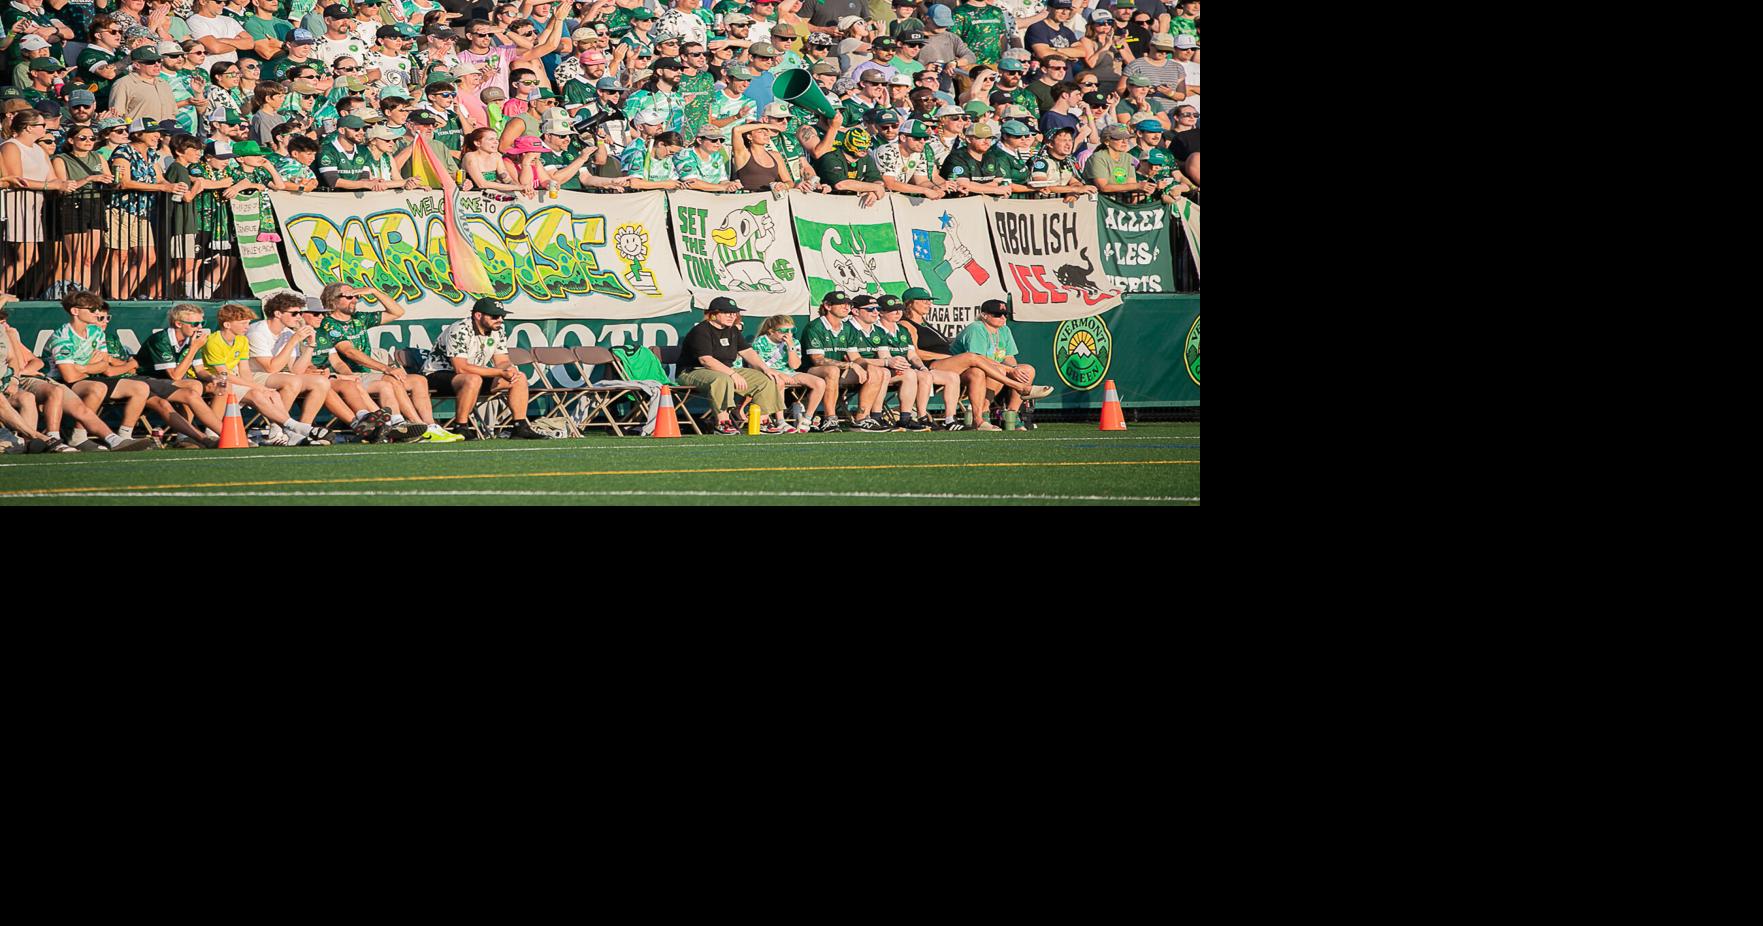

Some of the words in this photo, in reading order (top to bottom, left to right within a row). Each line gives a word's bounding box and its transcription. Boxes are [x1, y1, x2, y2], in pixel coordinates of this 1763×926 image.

[406, 196, 482, 218] WELCME
[1105, 207, 1164, 232] ALLEZ
[677, 205, 708, 238] SET
[995, 211, 1078, 255] ABOLISH
[682, 235, 707, 256] THE
[1114, 242, 1153, 266] LES
[682, 253, 730, 291] TONE
[1008, 262, 1069, 304] ICE
[953, 306, 972, 322] GET
[1060, 316, 1107, 343] VERMONT
[1065, 364, 1099, 384] GREEN
